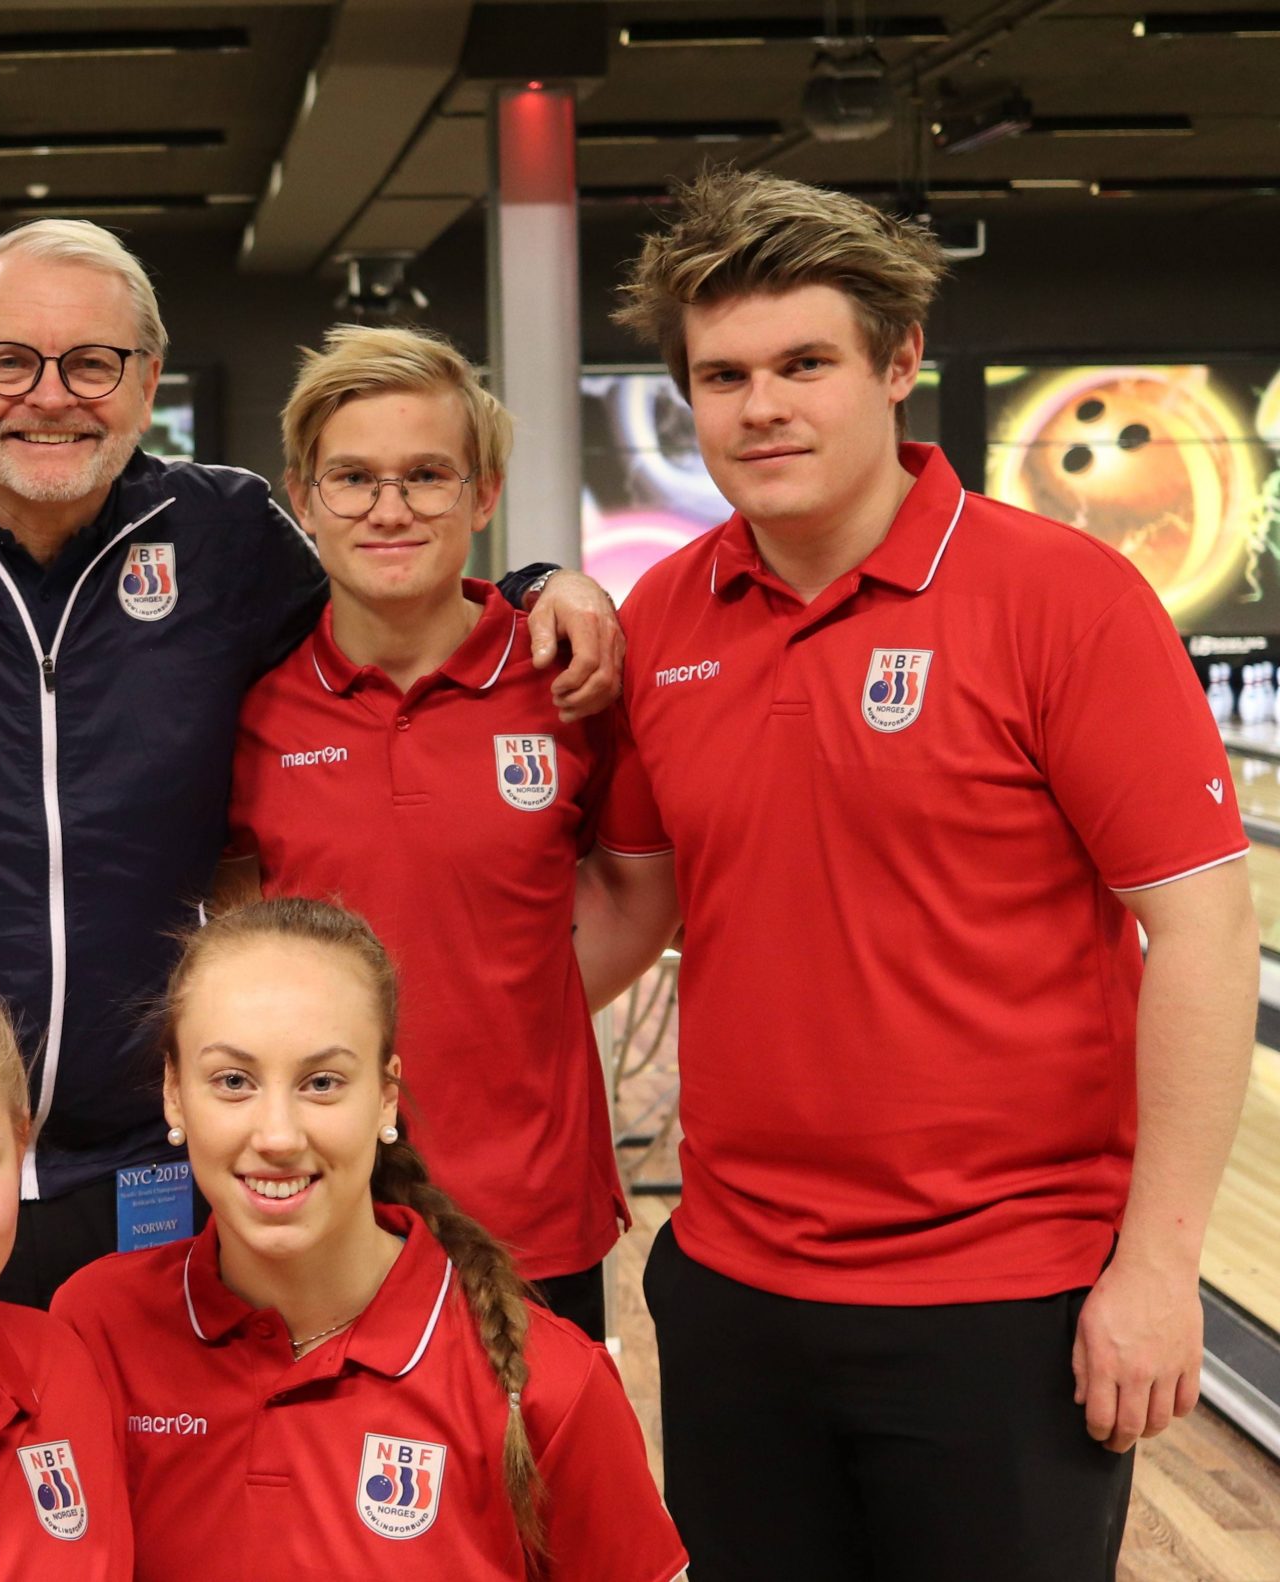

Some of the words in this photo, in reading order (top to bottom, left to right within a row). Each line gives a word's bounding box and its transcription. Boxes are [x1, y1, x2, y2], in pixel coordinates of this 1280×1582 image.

[656, 660, 720, 687] macron
[876, 706, 905, 714] NORGES
[281, 746, 347, 768] macron
[119, 1169, 152, 1187] NYC
[156, 1164, 189, 1182] 2019
[132, 1219, 178, 1235] NORWAY
[128, 1413, 207, 1434] macron
[52, 1508, 79, 1520] NORGES
[364, 1505, 430, 1533] BOWLINGFORBUND
[377, 1506, 416, 1519] NORGES
